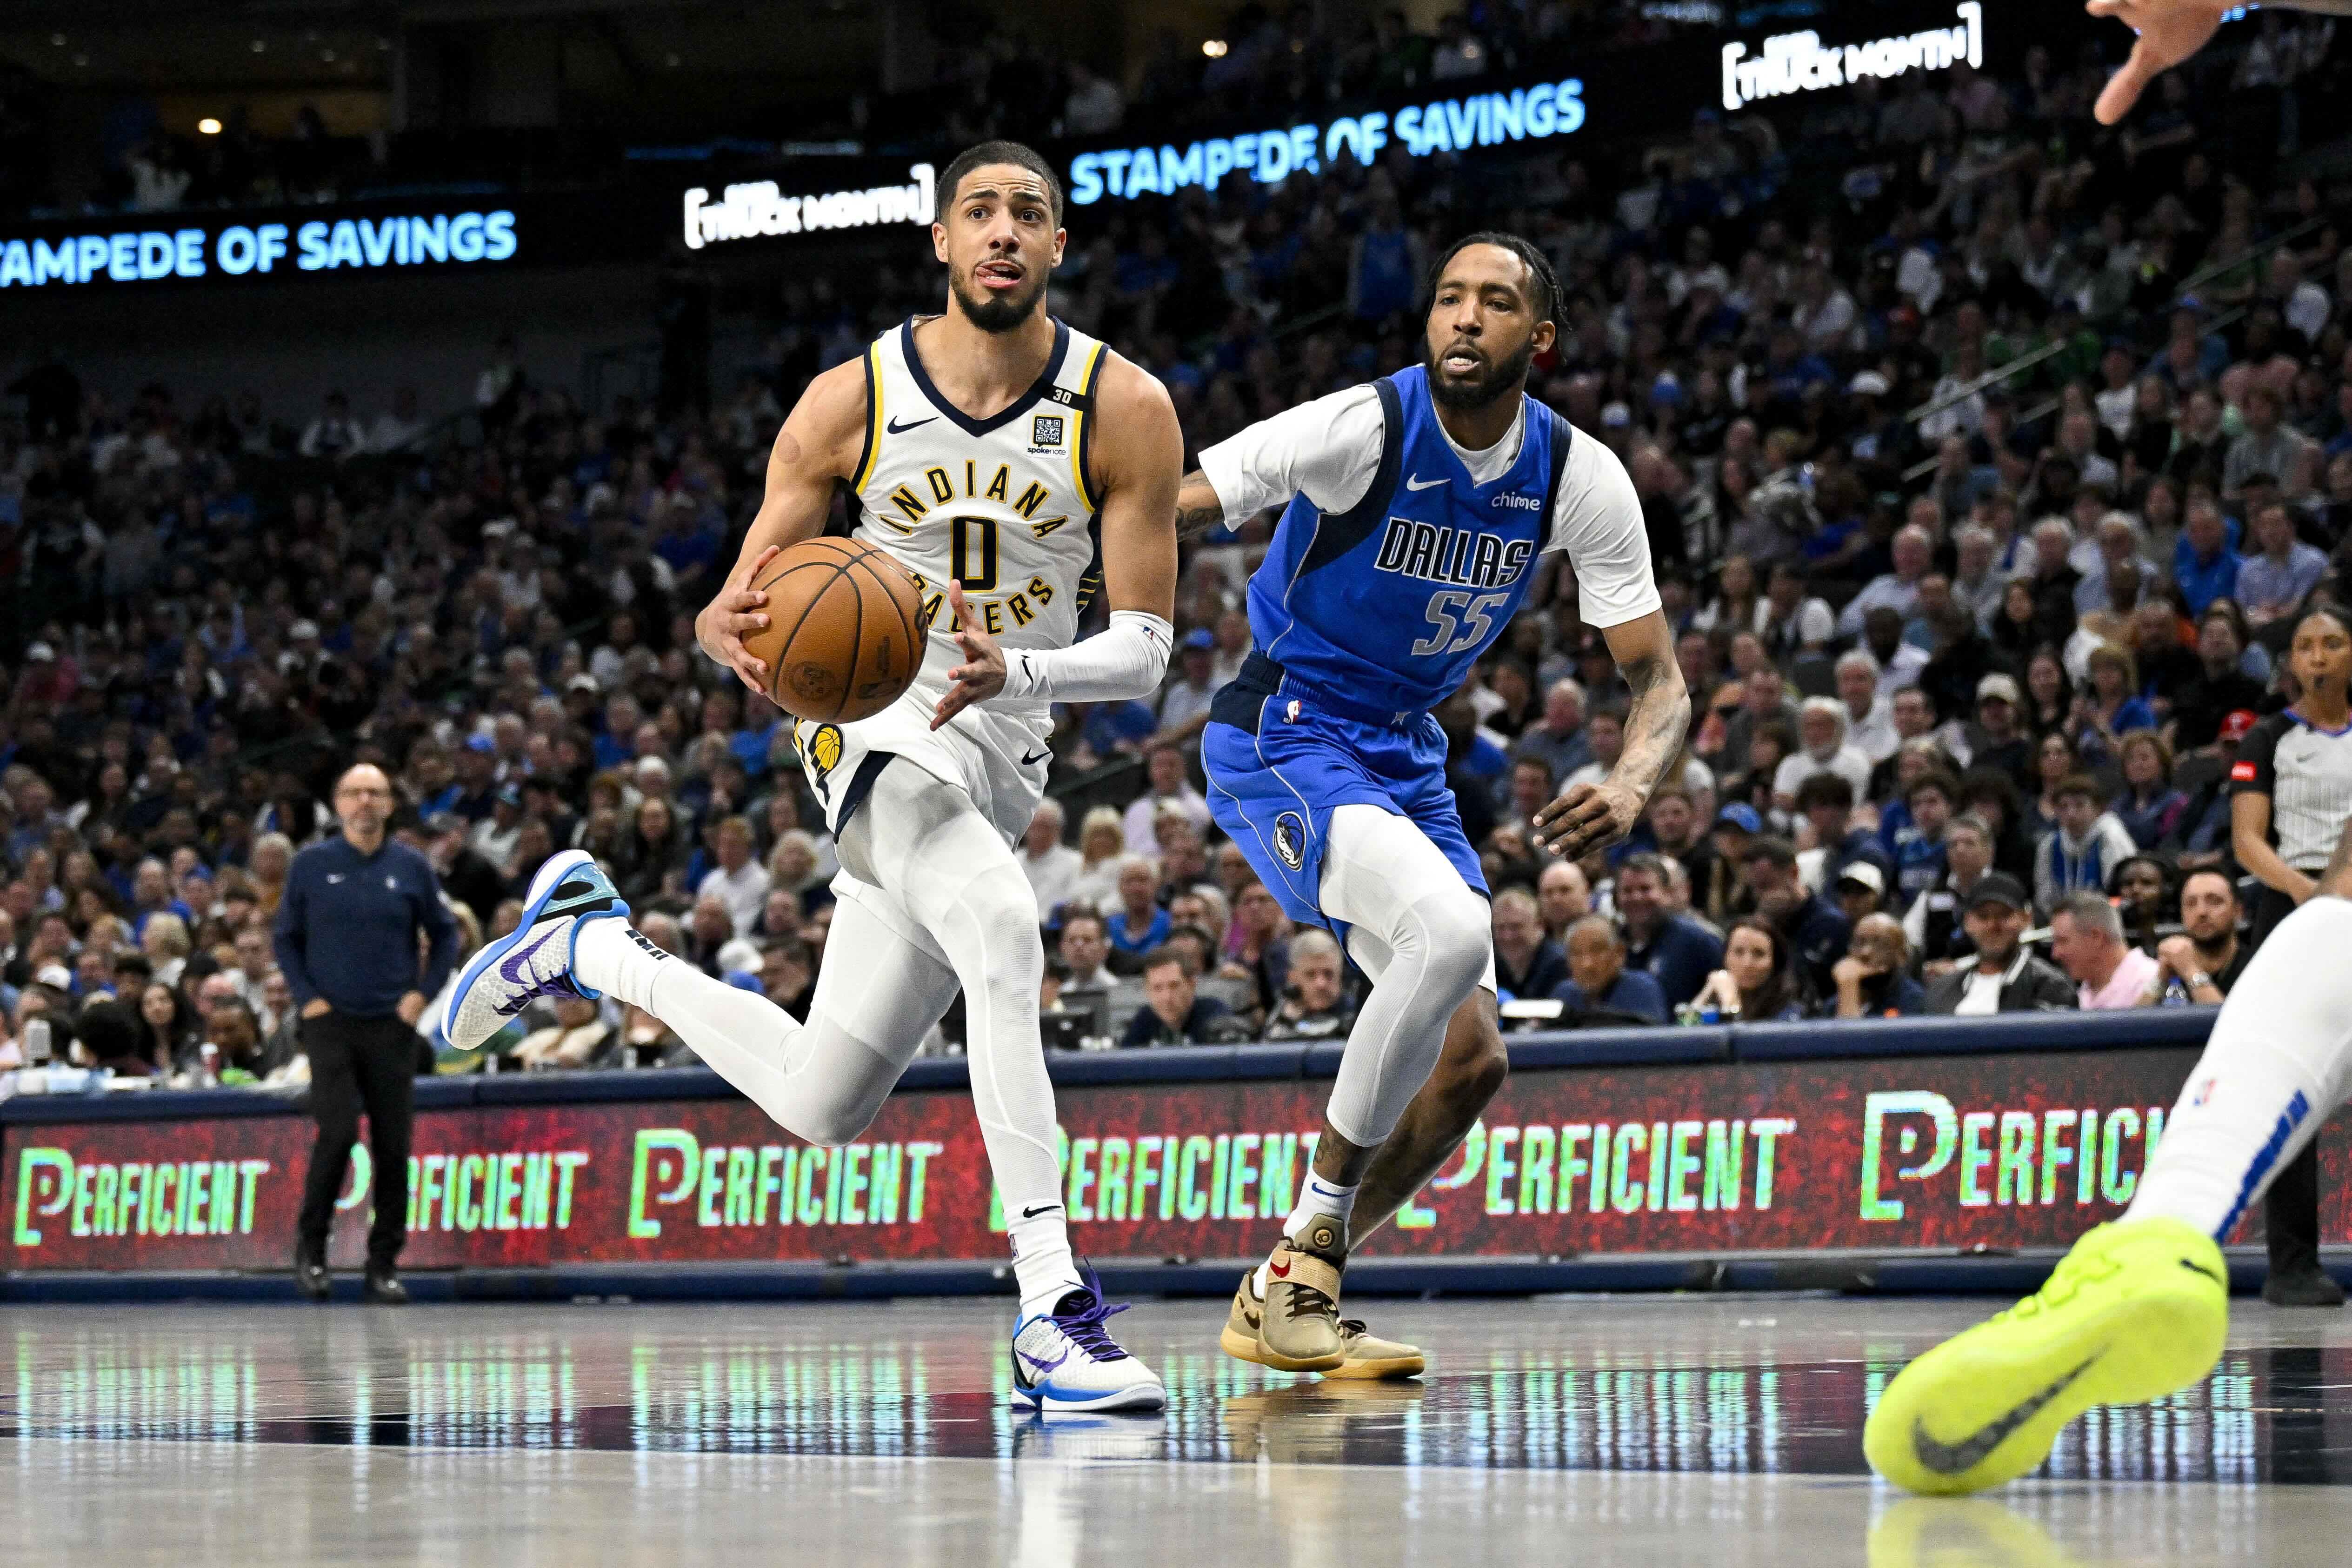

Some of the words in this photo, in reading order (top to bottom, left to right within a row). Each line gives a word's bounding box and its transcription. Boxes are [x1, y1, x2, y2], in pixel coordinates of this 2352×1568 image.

[1071, 124, 1320, 205] STAMPEDE
[1325, 112, 1387, 166] OF
[1394, 78, 1586, 156] SAVINGS
[0, 228, 206, 288] AMPEDE
[217, 223, 288, 275] OF
[297, 209, 517, 271] SAVINGS
[1053, 389, 1072, 404] 30
[1027, 447, 1066, 455] spokenote
[880, 459, 1069, 540] INDIANA
[1491, 491, 1541, 511] chime
[950, 516, 999, 593] 0
[1373, 516, 1534, 589] DALLAS
[1411, 590, 1510, 656] 55
[14, 1147, 271, 1246] PERFICIENT
[628, 1128, 944, 1238] PERFICIENT
